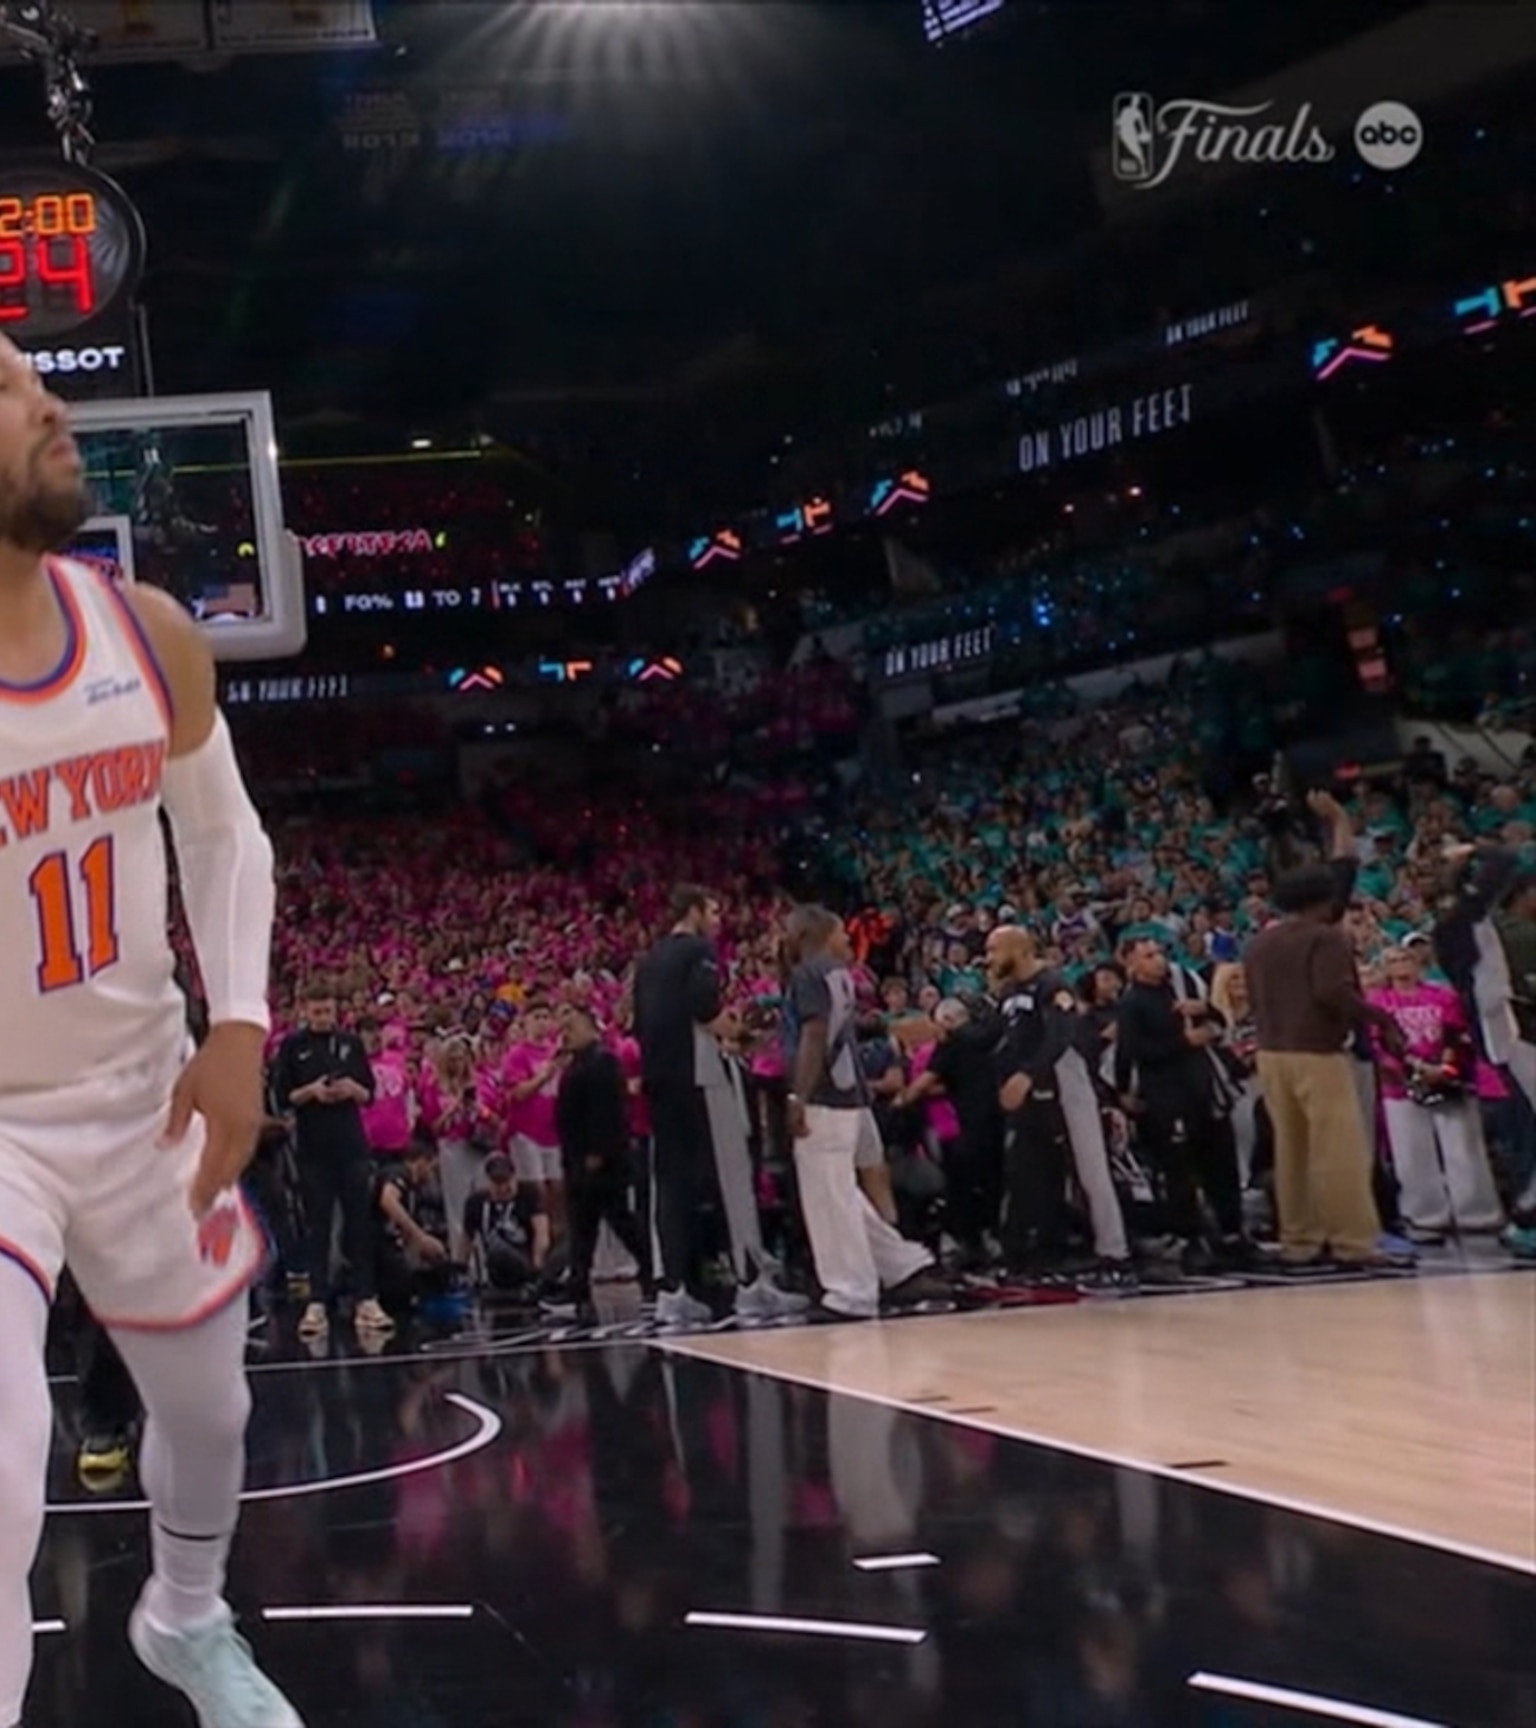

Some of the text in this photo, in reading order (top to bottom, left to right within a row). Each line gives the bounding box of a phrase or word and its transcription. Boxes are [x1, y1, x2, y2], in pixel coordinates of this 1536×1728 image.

[17, 346, 124, 374] ISSOT
[1019, 384, 1193, 472] ON YOUR FEET
[432, 589, 461, 607] TO
[28, 832, 118, 994] 11
